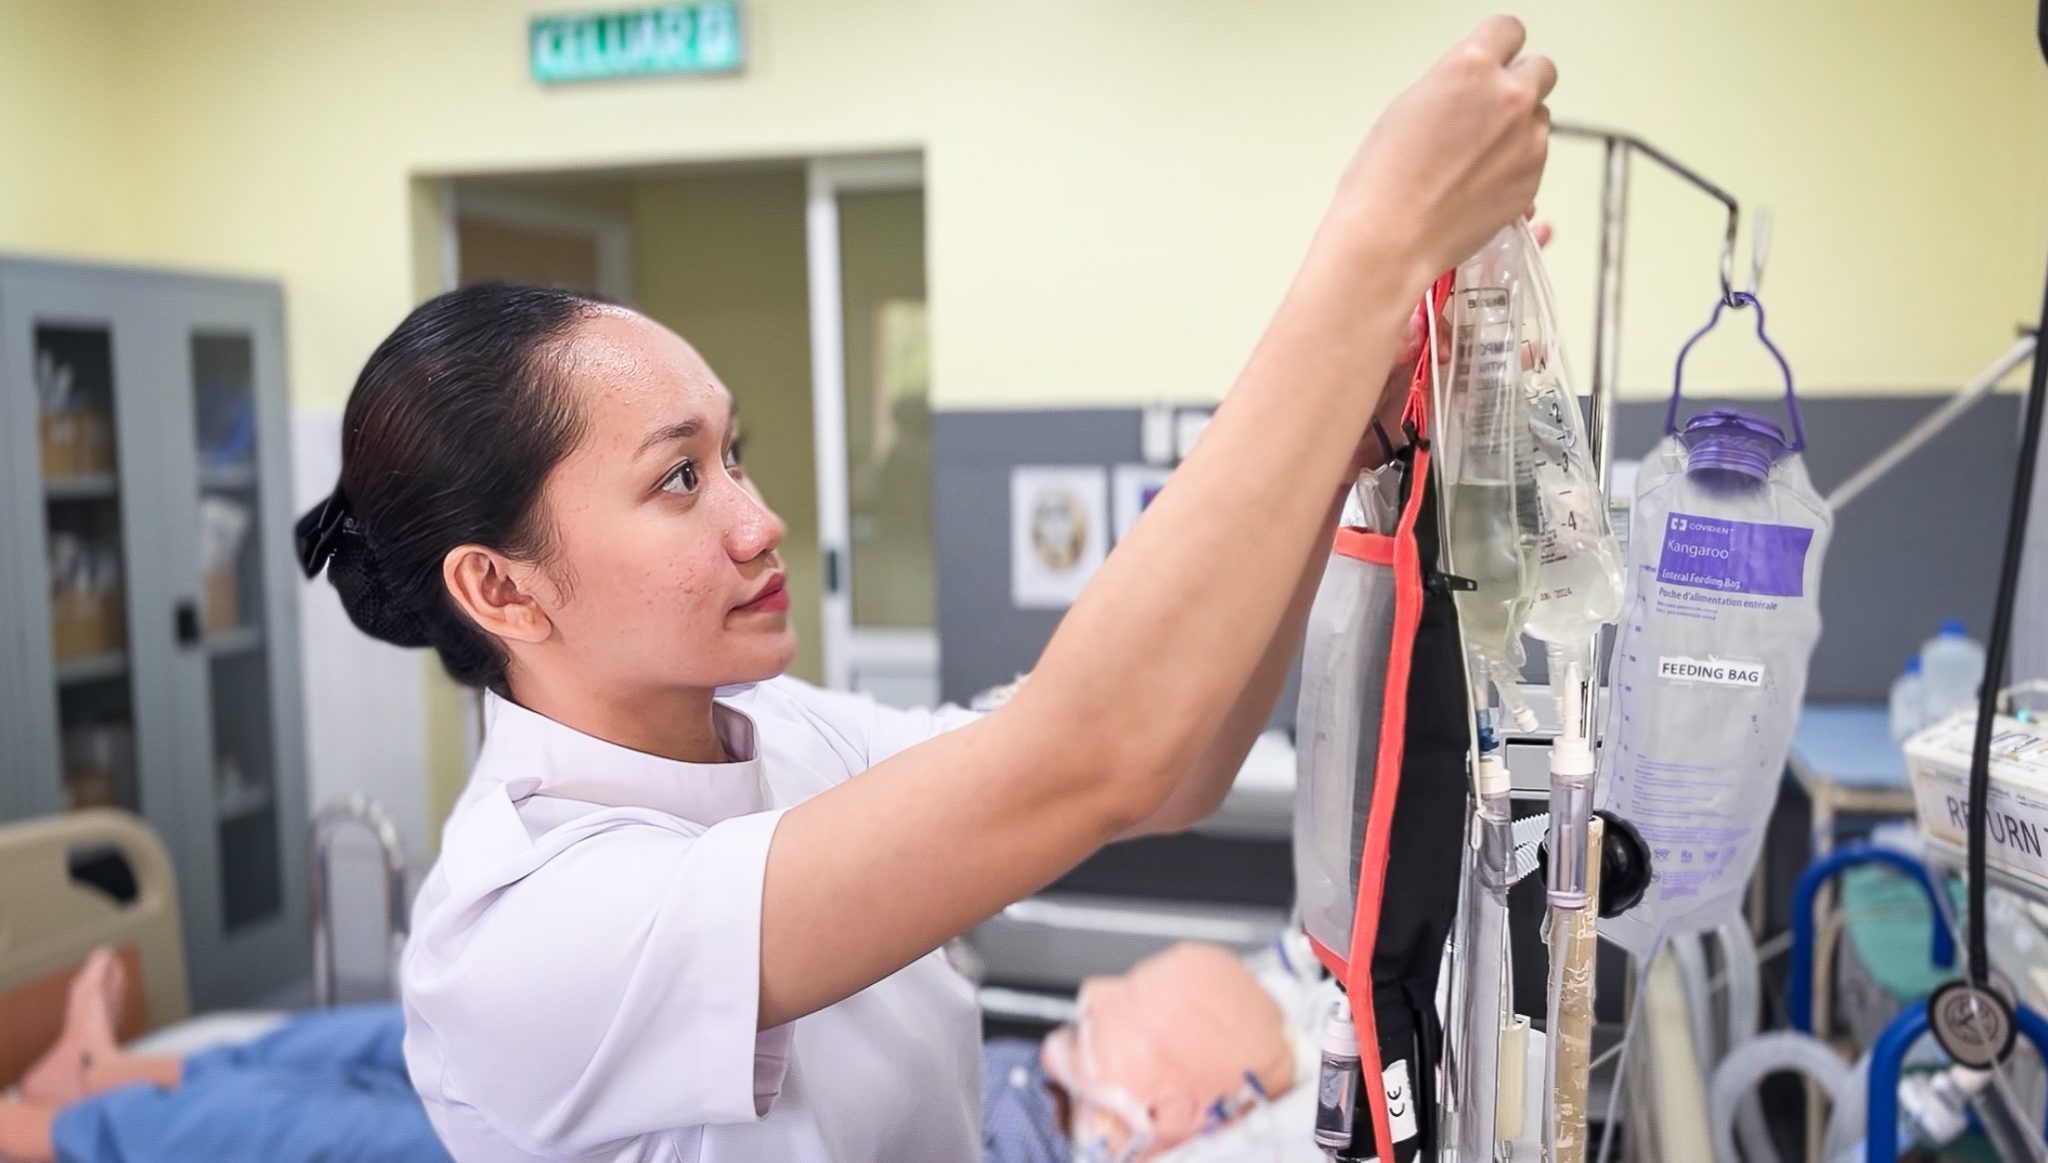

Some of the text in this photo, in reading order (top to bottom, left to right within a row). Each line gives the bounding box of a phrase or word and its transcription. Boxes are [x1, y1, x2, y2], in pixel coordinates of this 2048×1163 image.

[1689, 523, 1729, 535] COVIDIEN
[1667, 540, 1729, 559] Kangaroo
[1662, 569, 1741, 590] Enteral Feeding Bag
[1659, 587, 1681, 600] Poche
[1683, 590, 1743, 608] d'alimentation
[1662, 662, 1759, 683] FEEDING BAG
[1946, 796, 2041, 858] REURN
